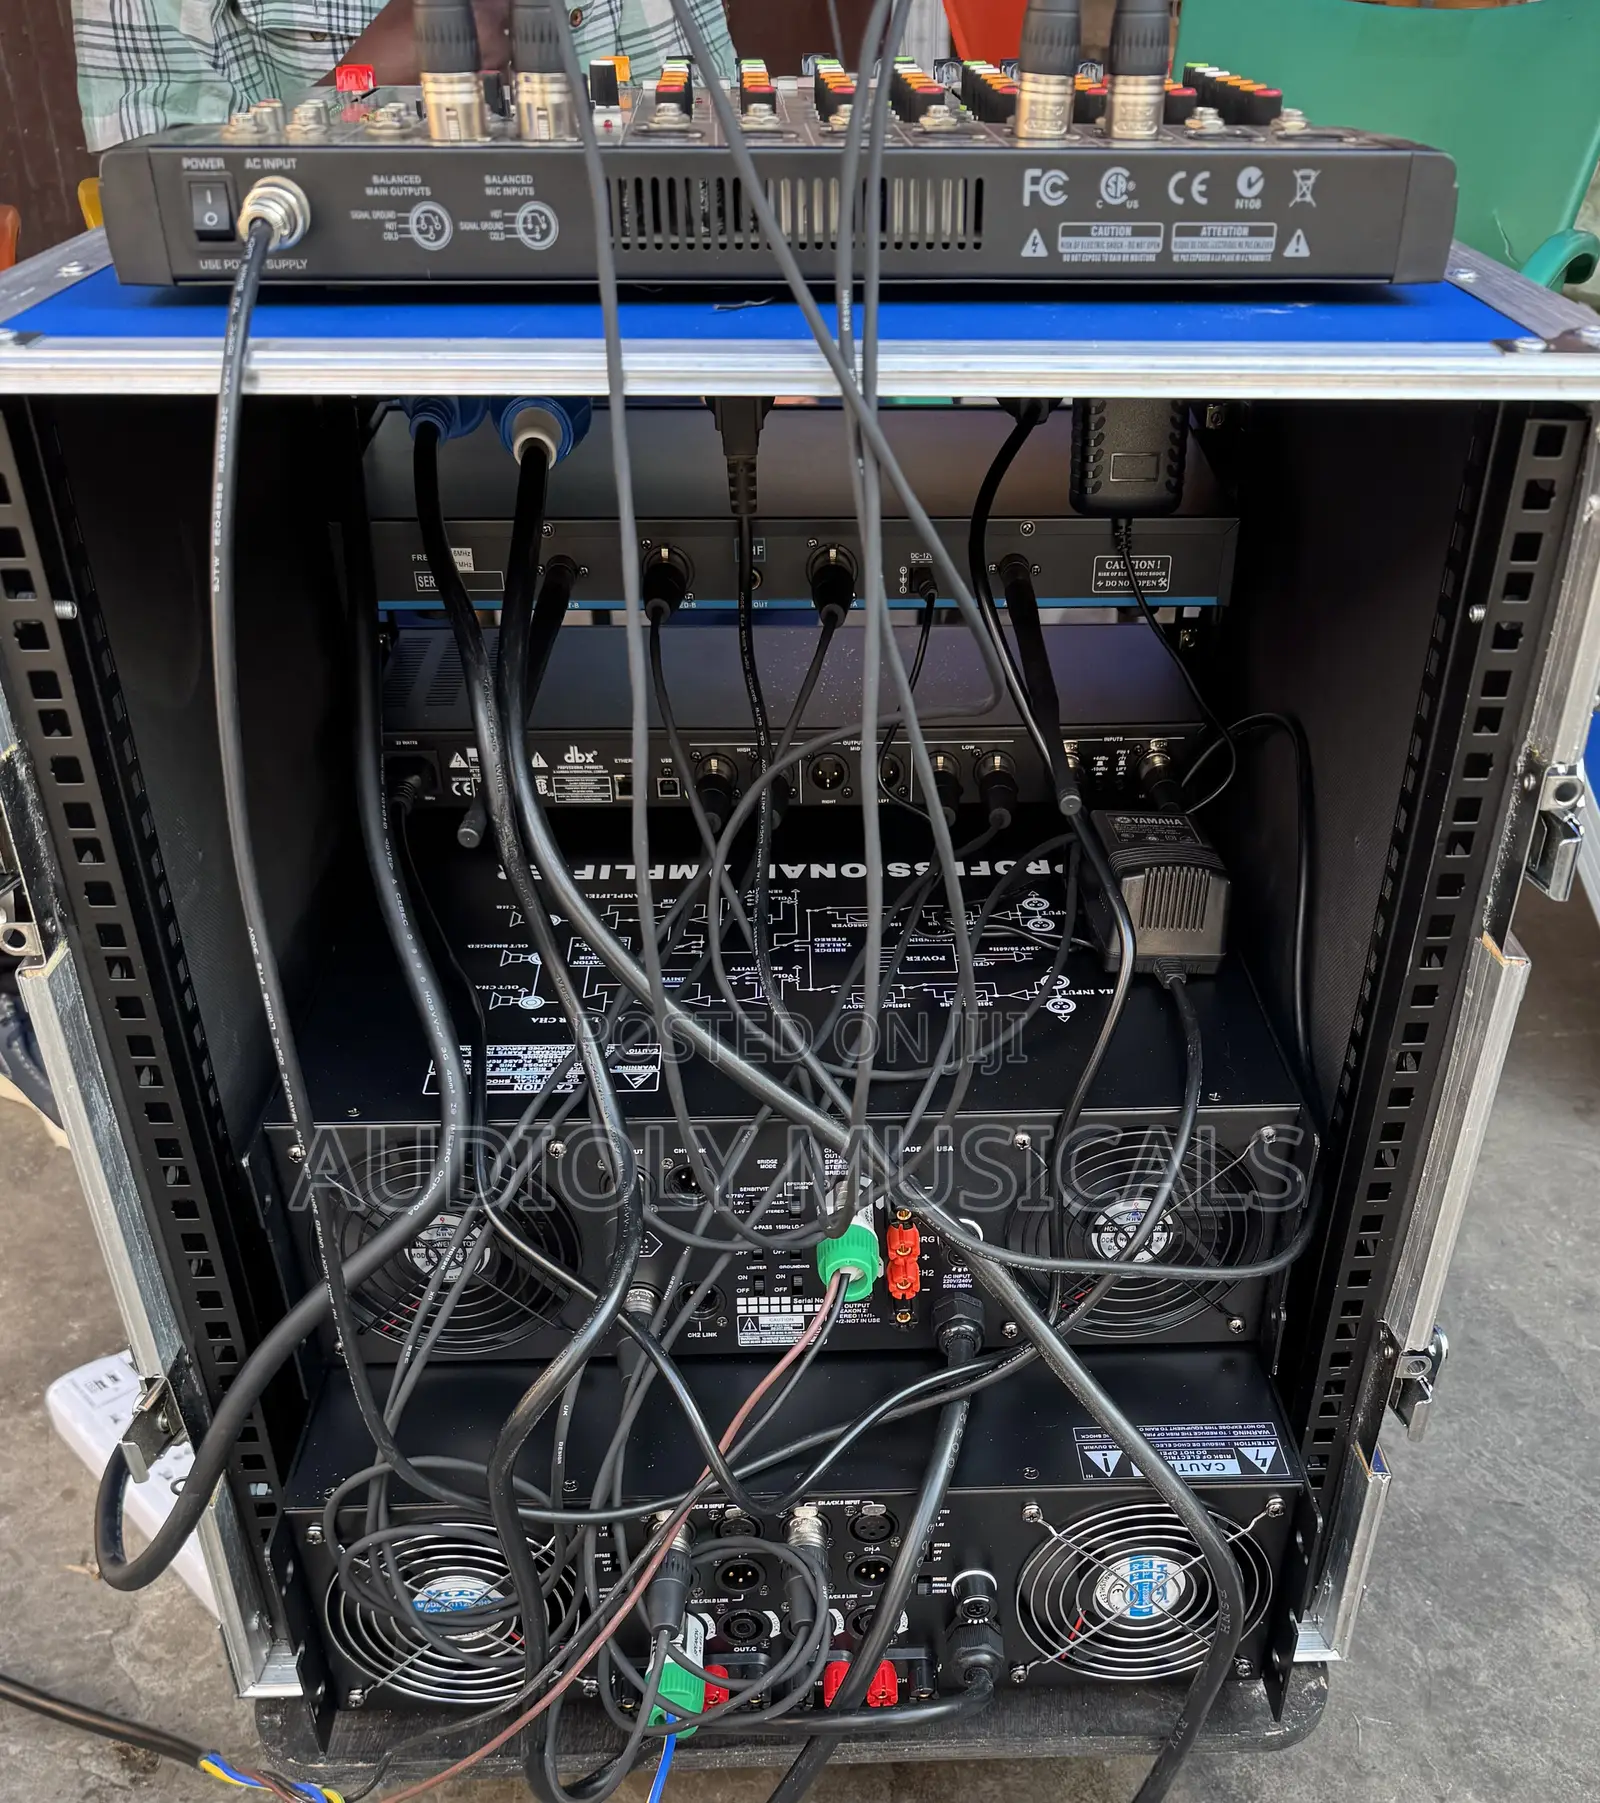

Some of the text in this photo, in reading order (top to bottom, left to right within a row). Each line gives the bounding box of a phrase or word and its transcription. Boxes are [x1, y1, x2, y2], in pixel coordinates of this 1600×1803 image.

[182, 157, 225, 169] POWER
[244, 157, 297, 169] AC INPUT
[372, 175, 421, 184] BALANCED
[484, 175, 533, 184] BALANCED
[365, 187, 431, 196] MAIN OUTPUTS
[485, 187, 534, 196] MIC INPUTS
[1168, 171, 1210, 205] CE
[1091, 226, 1131, 236] CAUTION
[1200, 226, 1249, 236] ATTENTION
[266, 259, 308, 270] SUPPLY
[1105, 560, 1155, 569] CAUION
[760, 787, 768, 813] UNITE
[1132, 817, 1184, 826] YAMAHA
[441, 1246, 456, 1270] DESIGN
[556, 1404, 570, 1464] UK DESIGN
